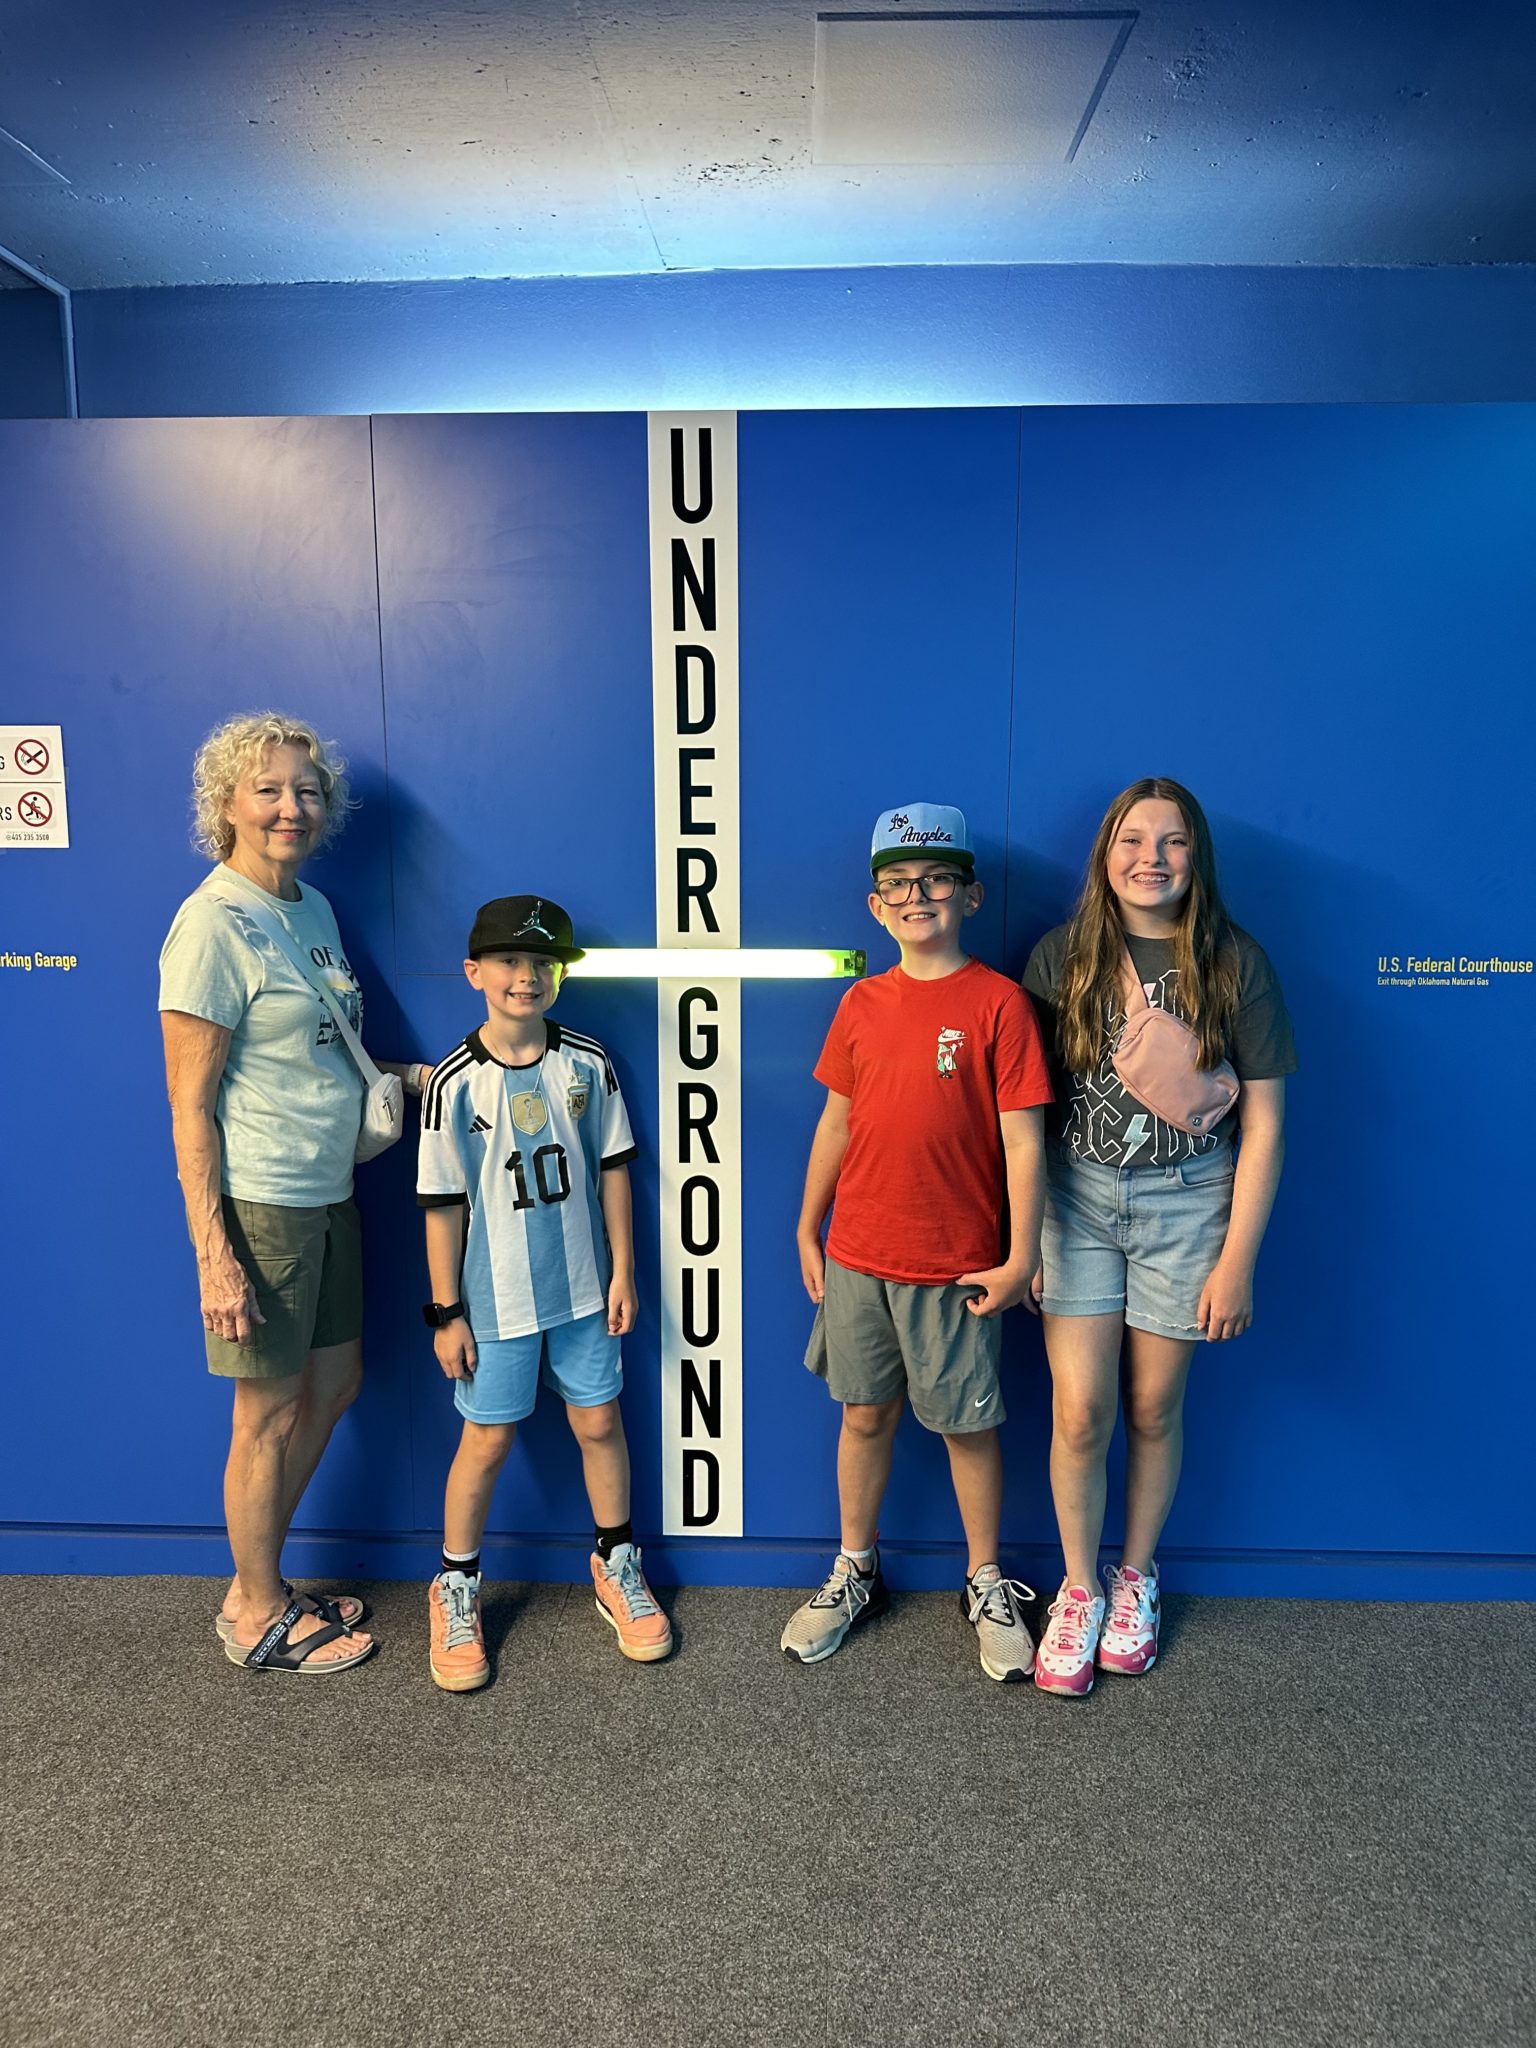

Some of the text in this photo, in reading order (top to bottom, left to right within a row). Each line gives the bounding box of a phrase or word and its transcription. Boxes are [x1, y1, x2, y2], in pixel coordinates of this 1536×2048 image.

[888, 813, 910, 833] Los
[900, 826, 954, 848] Angeles
[0, 951, 78, 972] rking Garage
[310, 946, 334, 968] OF
[1378, 956, 1534, 973] U.S. Federal Courthouse
[1377, 977, 1489, 988] Exit through Oklahoma Natural Gas
[505, 1143, 571, 1211] 10
